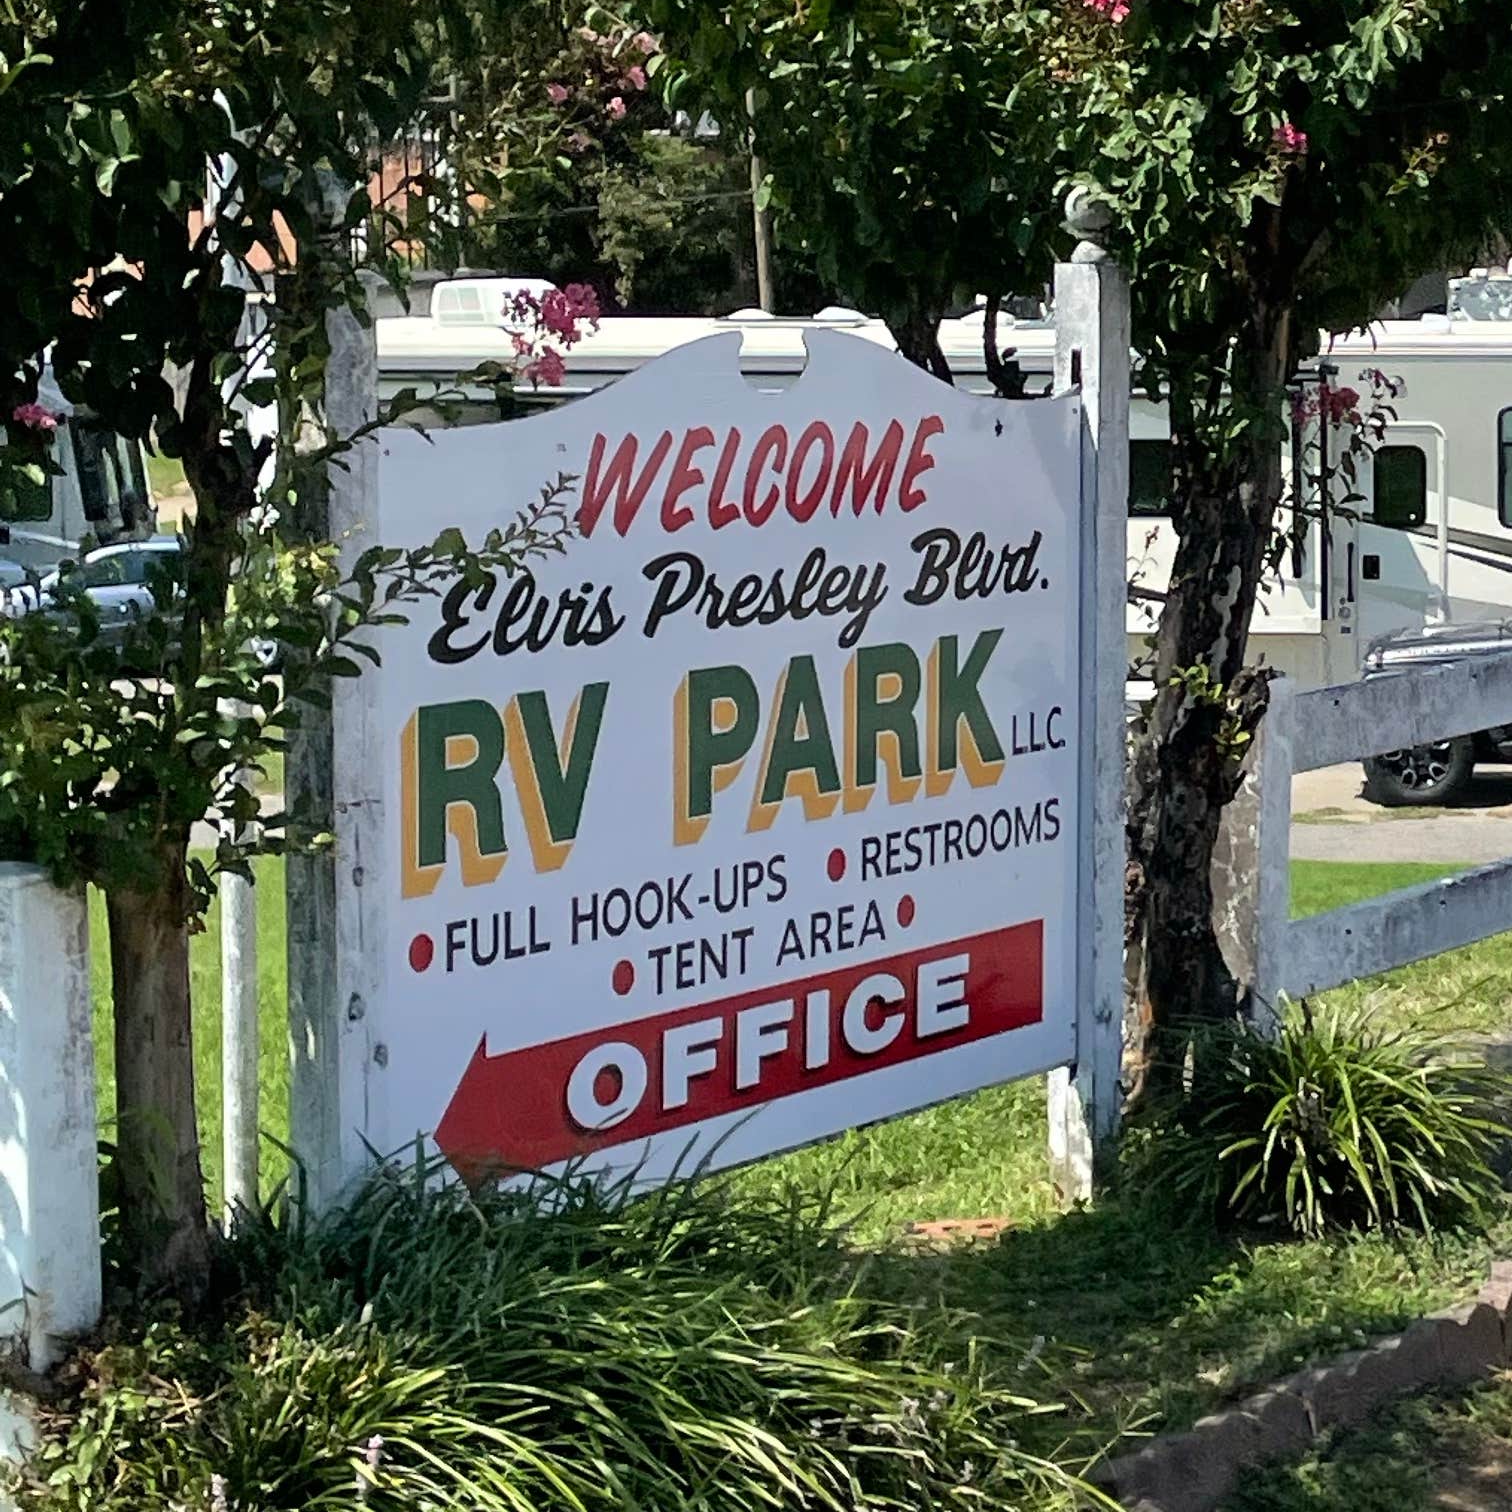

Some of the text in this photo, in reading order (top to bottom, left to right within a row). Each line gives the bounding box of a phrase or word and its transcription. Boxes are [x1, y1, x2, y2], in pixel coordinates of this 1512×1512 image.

[577, 415, 944, 538] WELCOME
[428, 527, 1050, 664] Elvis Presley Blvd.
[400, 680, 610, 900] RV
[672, 627, 1006, 848] PARK
[860, 798, 1061, 881] RESTROOMS
[445, 854, 788, 972] FULL HOOK-UPS
[647, 899, 887, 996] TENT AREA
[566, 952, 971, 1132] OFFICE
